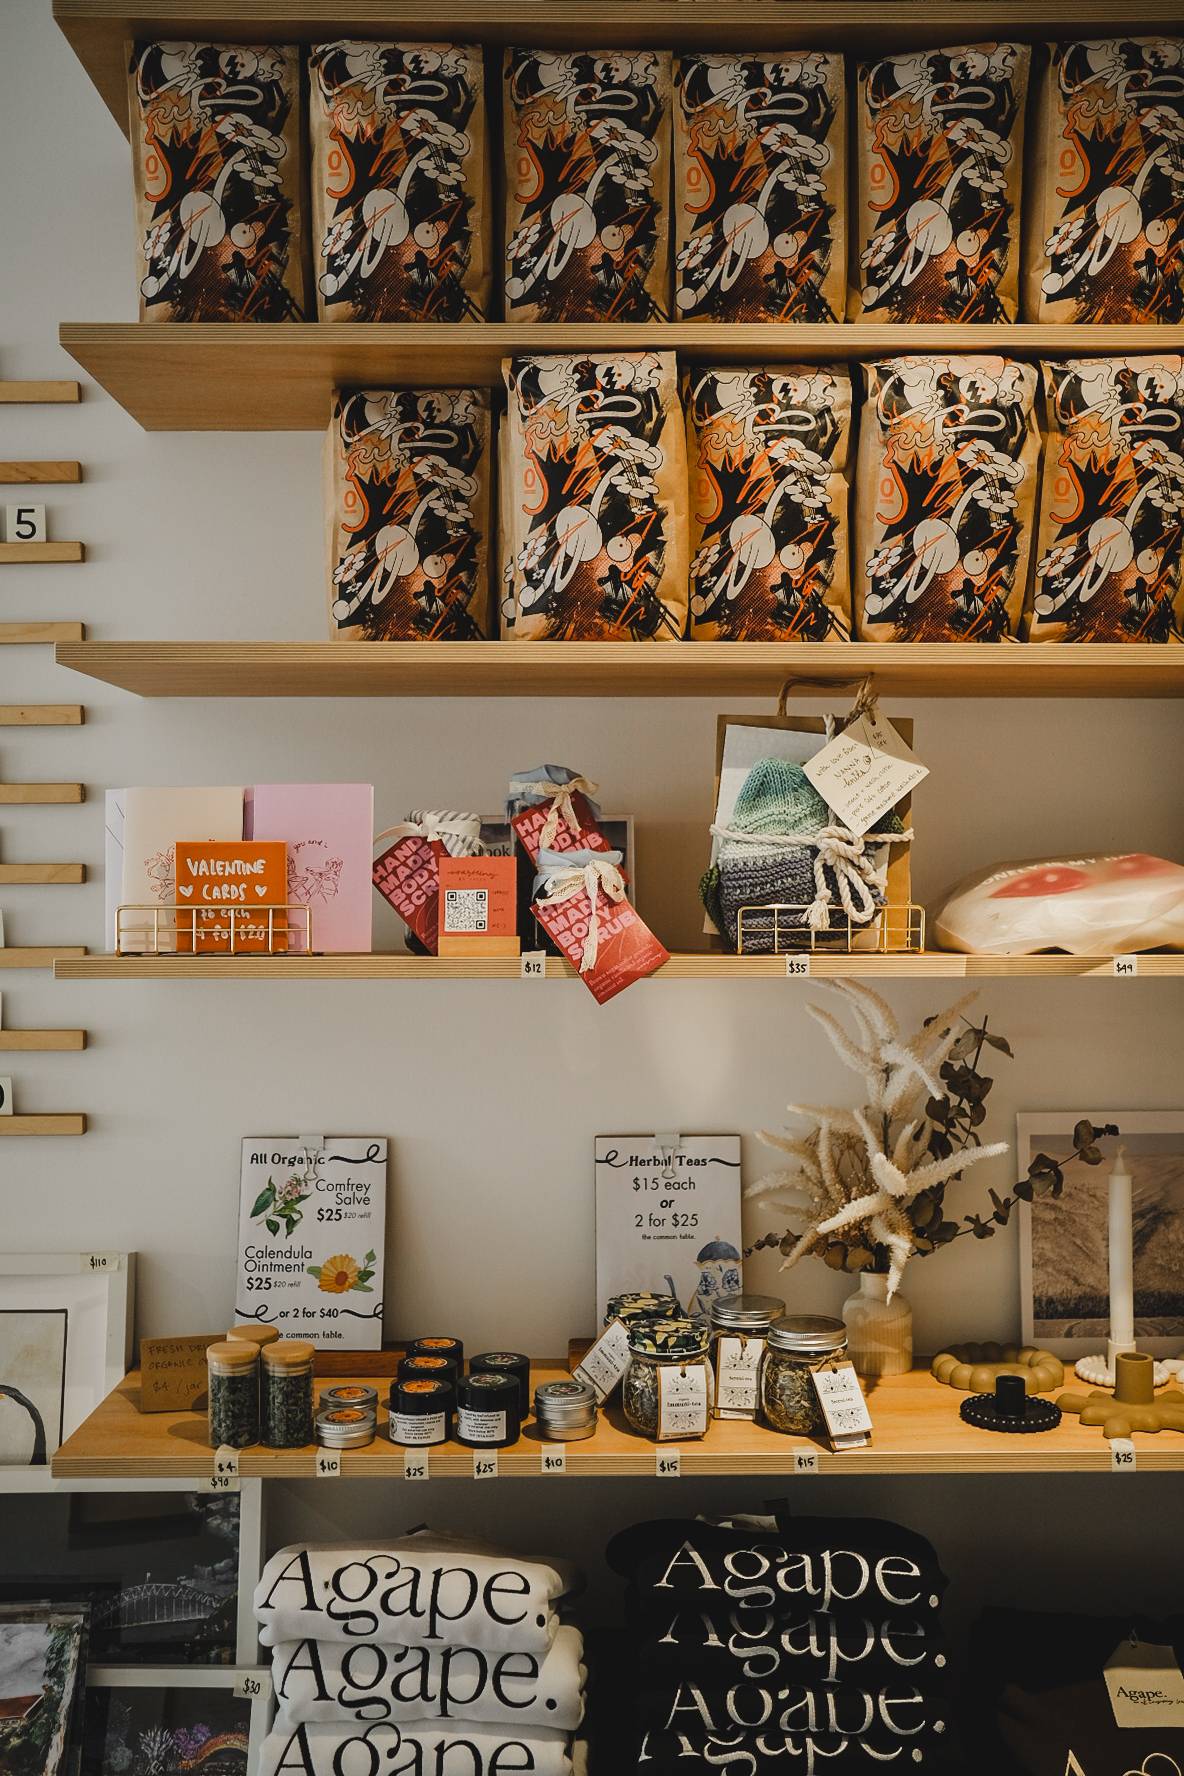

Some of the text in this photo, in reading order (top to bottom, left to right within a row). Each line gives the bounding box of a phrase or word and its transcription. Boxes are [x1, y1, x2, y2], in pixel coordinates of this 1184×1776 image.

[15, 508, 37, 540] 5
[186, 858, 267, 877] VALENTINE
[372, 837, 423, 883] HAND
[379, 844, 434, 895] MADE
[389, 855, 439, 906] BODY
[202, 884, 247, 901] CARDS
[399, 875, 440, 917] SCR
[221, 908, 251, 920] each
[212, 924, 232, 941] fo
[557, 905, 612, 948] BOY
[568, 910, 637, 960] SRUB
[525, 962, 541, 974] $12
[788, 960, 808, 974] $35
[250, 1153, 326, 1168] All Organic
[675, 1155, 708, 1167] Teas
[315, 1178, 371, 1197] Comfrey
[632, 1176, 696, 1191] $15 each
[335, 1192, 371, 1206] Salve
[659, 1199, 675, 1208] or
[316, 1207, 343, 1222] $25
[634, 1213, 699, 1228] 2 for $25
[244, 1245, 313, 1259] Calendula
[89, 1256, 107, 1270] $110
[244, 1259, 305, 1273] Ointment
[246, 1277, 272, 1291] $25
[279, 1307, 339, 1319] or 2 for $40
[545, 1458, 563, 1469] $10
[659, 1460, 678, 1472] $15
[797, 1456, 815, 1468] $15
[1115, 1452, 1133, 1465] $25
[218, 1461, 236, 1472] $4
[319, 1461, 338, 1472] $10
[406, 1466, 425, 1477] $25
[476, 1462, 495, 1474] $25
[653, 1540, 940, 1614] Agape.
[258, 1550, 546, 1639] Agape.
[242, 1679, 261, 1694] $30
[280, 1638, 557, 1720] Agape.
[1117, 1686, 1167, 1701] Agape.
